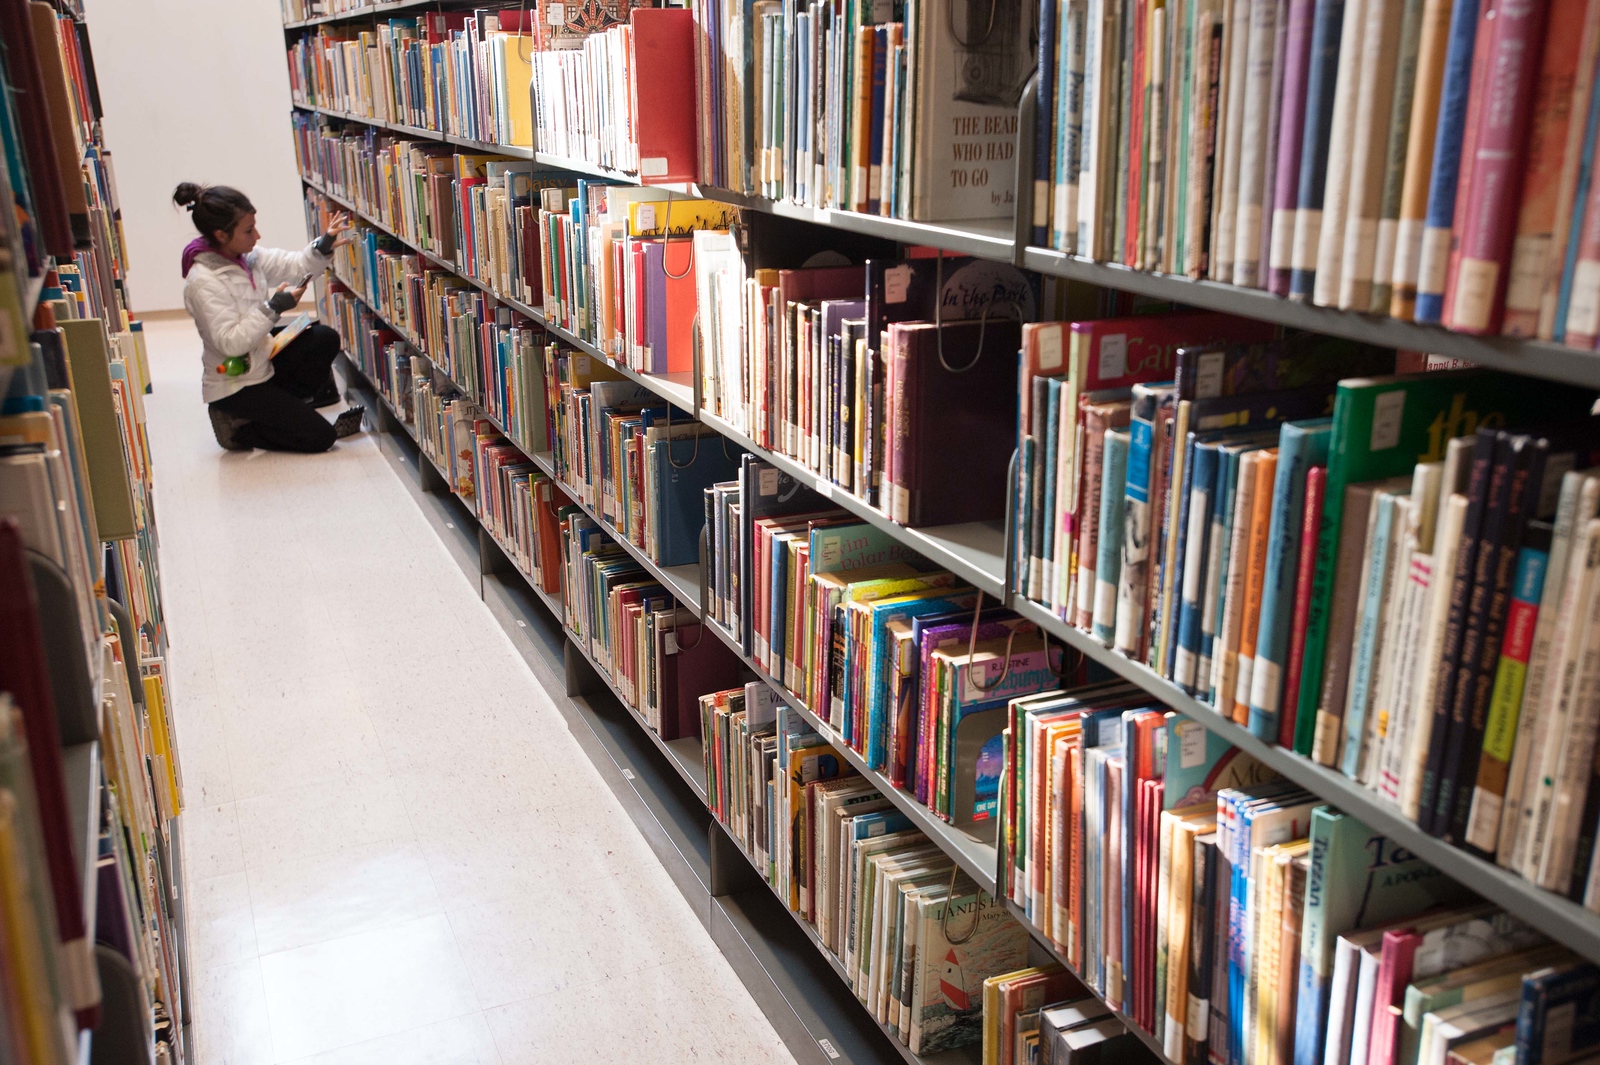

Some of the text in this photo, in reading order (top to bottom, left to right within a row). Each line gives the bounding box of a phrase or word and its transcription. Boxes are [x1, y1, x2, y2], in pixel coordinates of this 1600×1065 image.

[953, 114, 1018, 136] THE BEAR
[953, 142, 1014, 161] WHO HAD
[951, 168, 989, 188] TO GO
[991, 190, 1015, 206] by Ja
[943, 287, 957, 307] In
[959, 283, 988, 306] the
[841, 543, 927, 572] Polar Bea
[1007, 657, 1030, 671] STINE
[976, 803, 987, 812] ONE
[1309, 836, 1329, 908] Tarzan
[983, 910, 1000, 921] Mary
